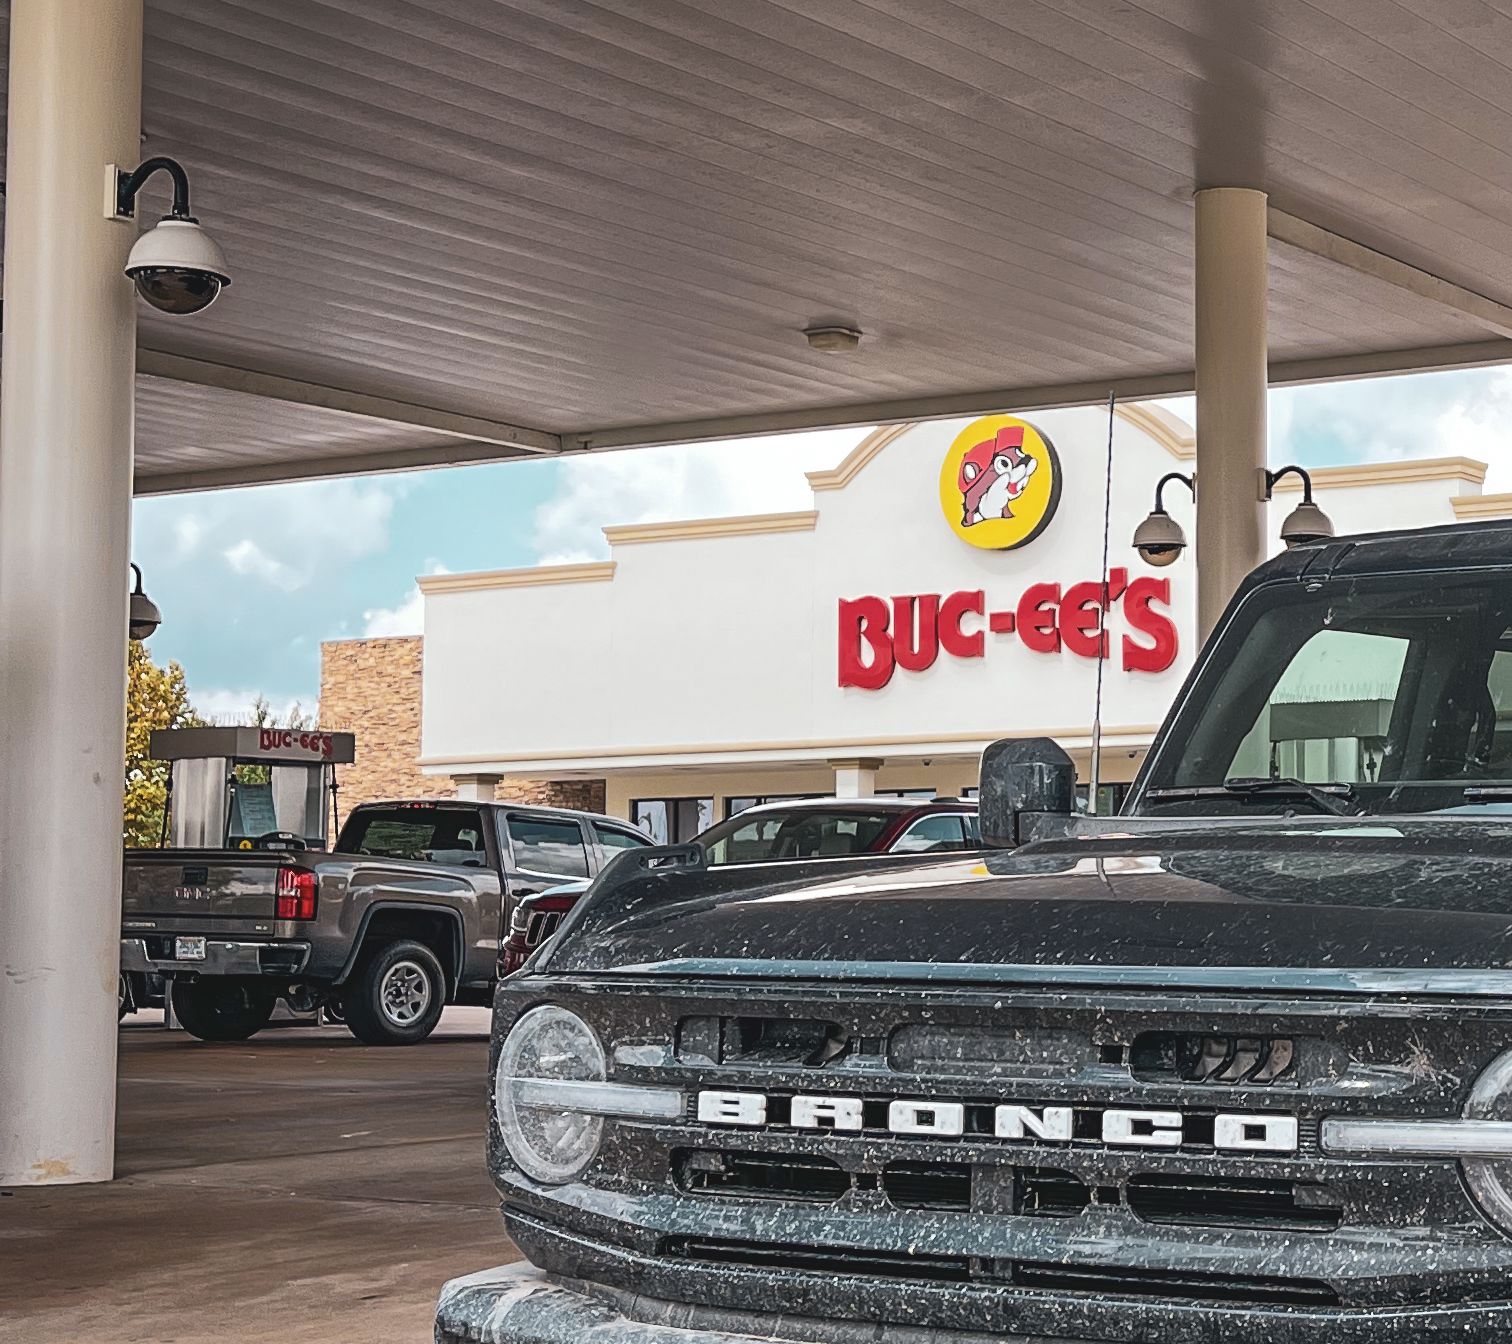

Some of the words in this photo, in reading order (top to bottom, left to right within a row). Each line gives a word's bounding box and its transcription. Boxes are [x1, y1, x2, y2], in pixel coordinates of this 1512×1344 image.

[838, 567, 1179, 690] BUC-EE'S
[259, 729, 334, 759] BUC-EE'S
[697, 1089, 1300, 1151] BRONCO
